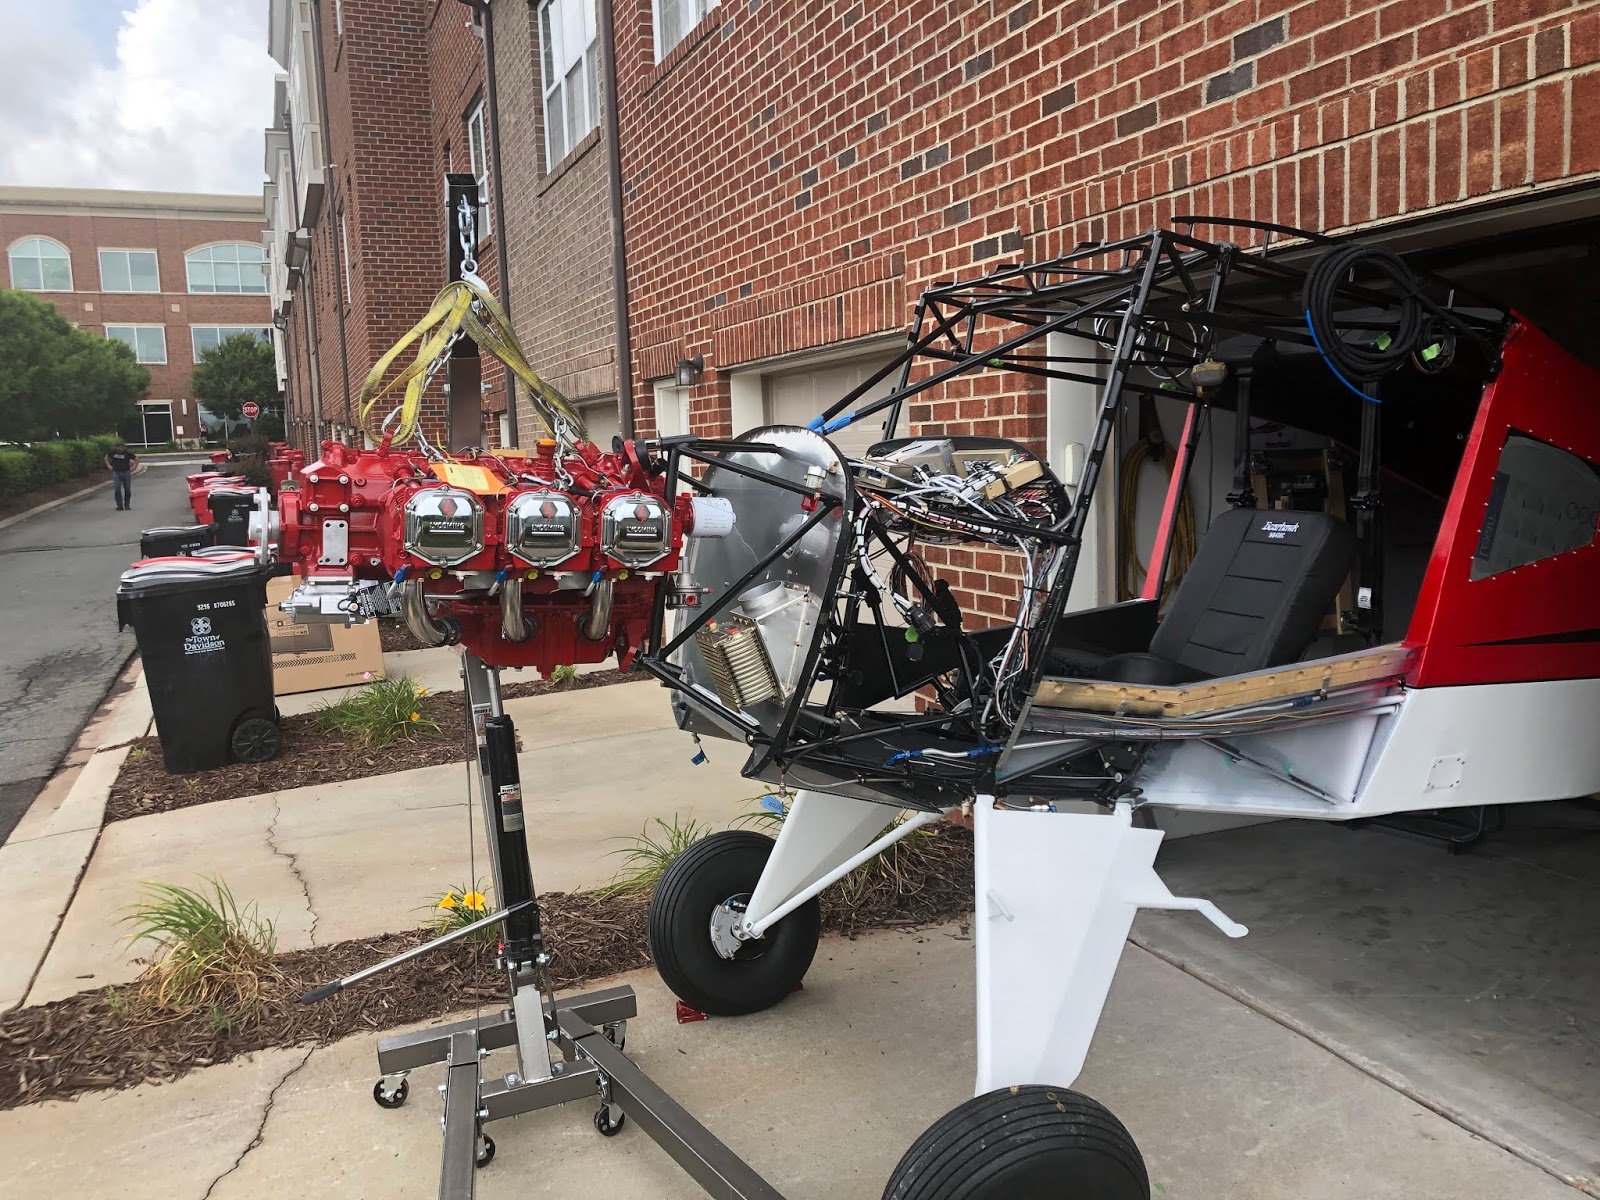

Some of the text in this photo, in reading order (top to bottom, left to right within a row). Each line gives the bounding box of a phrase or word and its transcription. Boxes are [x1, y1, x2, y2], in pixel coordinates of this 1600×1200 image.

[429, 521, 465, 530] LYCOMING
[531, 523, 565, 531] LYCOMING
[192, 635, 216, 643] Town
[183, 640, 225, 651] Davidson
